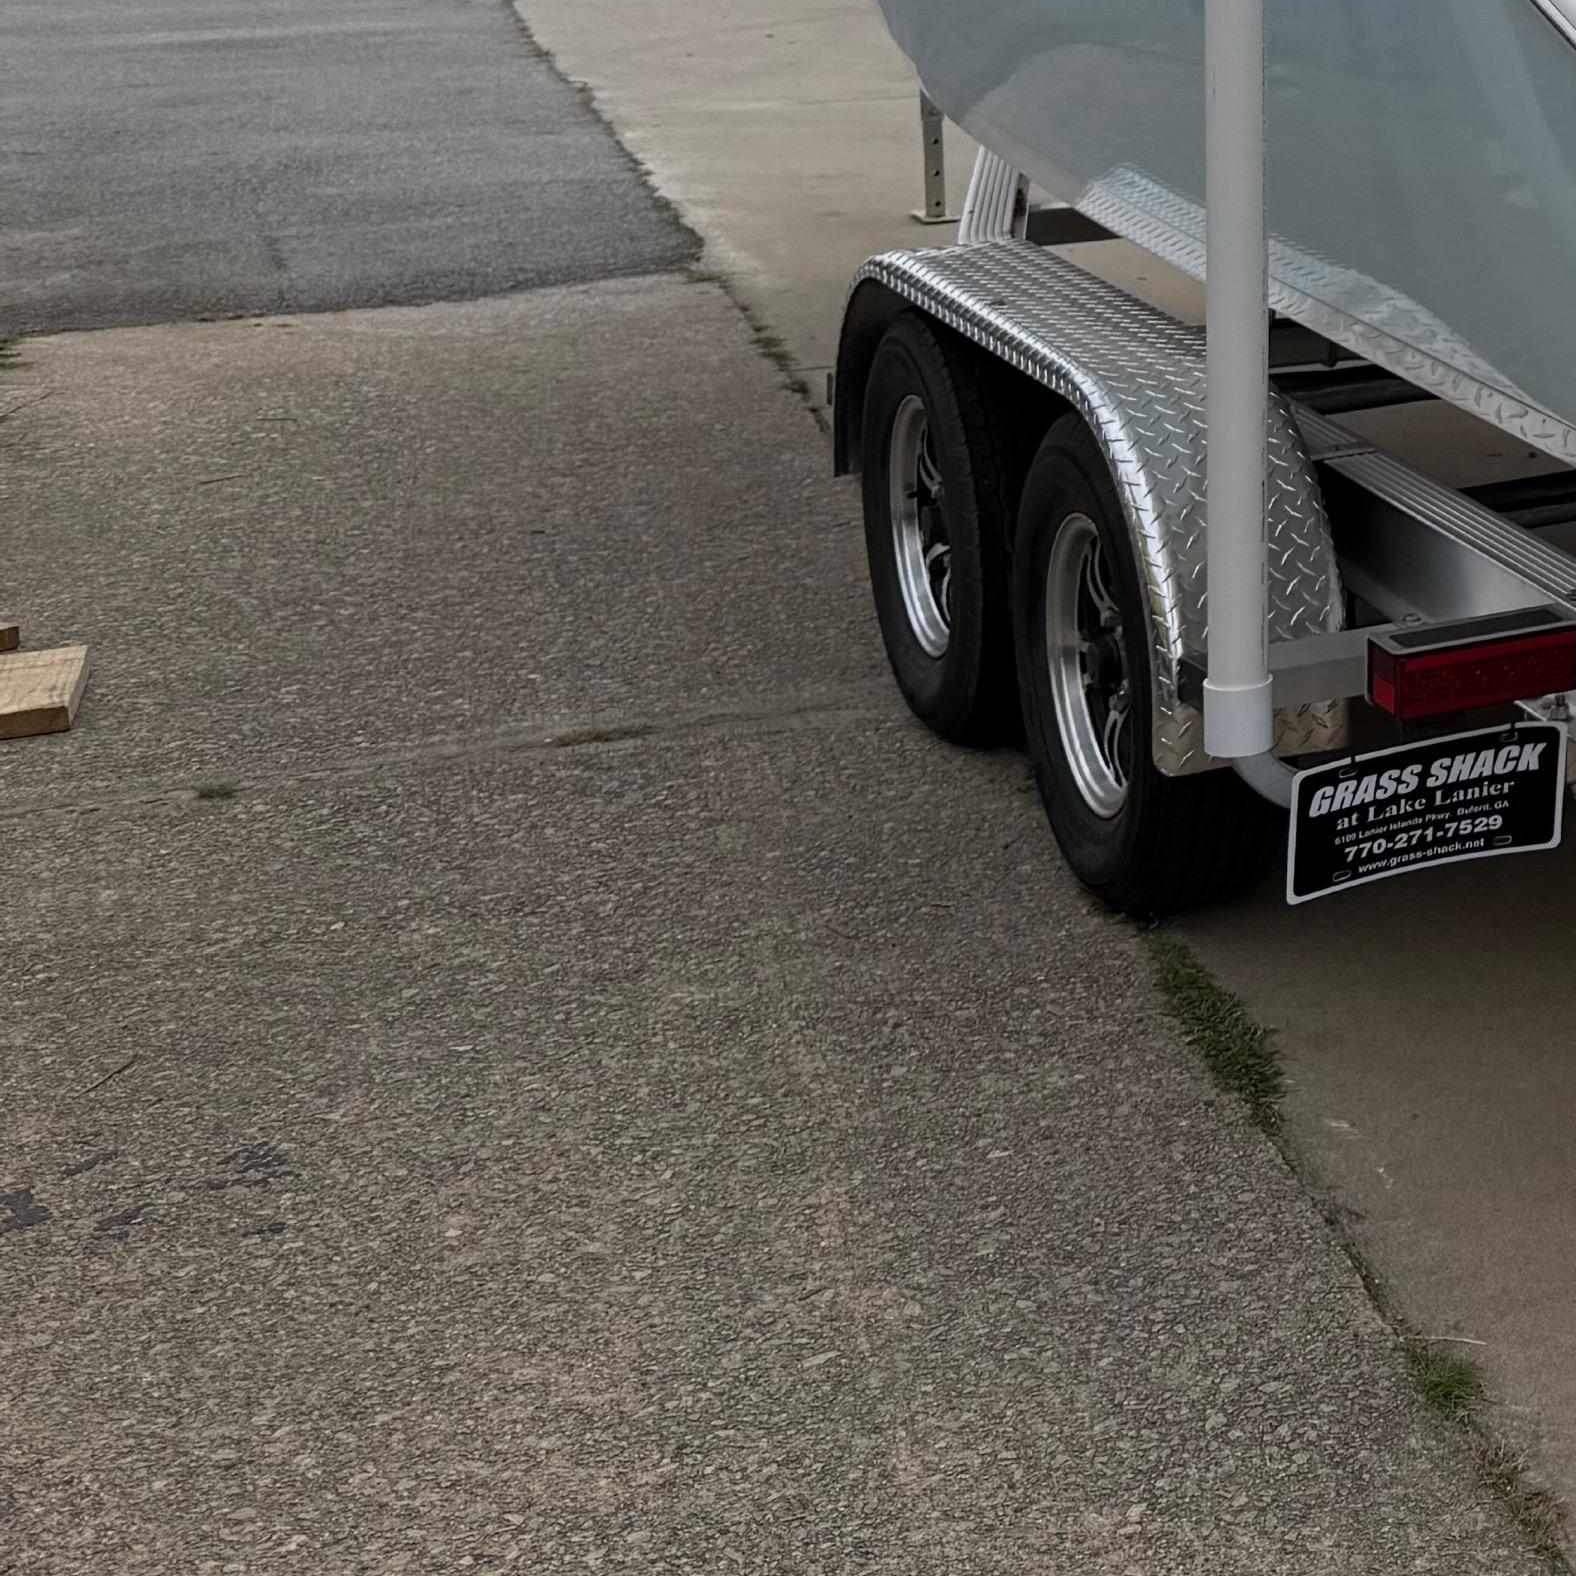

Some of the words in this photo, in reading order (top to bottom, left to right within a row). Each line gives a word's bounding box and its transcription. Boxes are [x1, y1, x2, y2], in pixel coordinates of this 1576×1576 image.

[1308, 763, 1423, 818] GRASS
[1426, 741, 1548, 788] SHACK
[1336, 813, 1359, 831] at
[1368, 797, 1427, 824] Lake
[1434, 779, 1515, 807] Lanier
[1343, 814, 1504, 863] 770-271-7529
[1357, 837, 1485, 873] www.grass-shack.net
